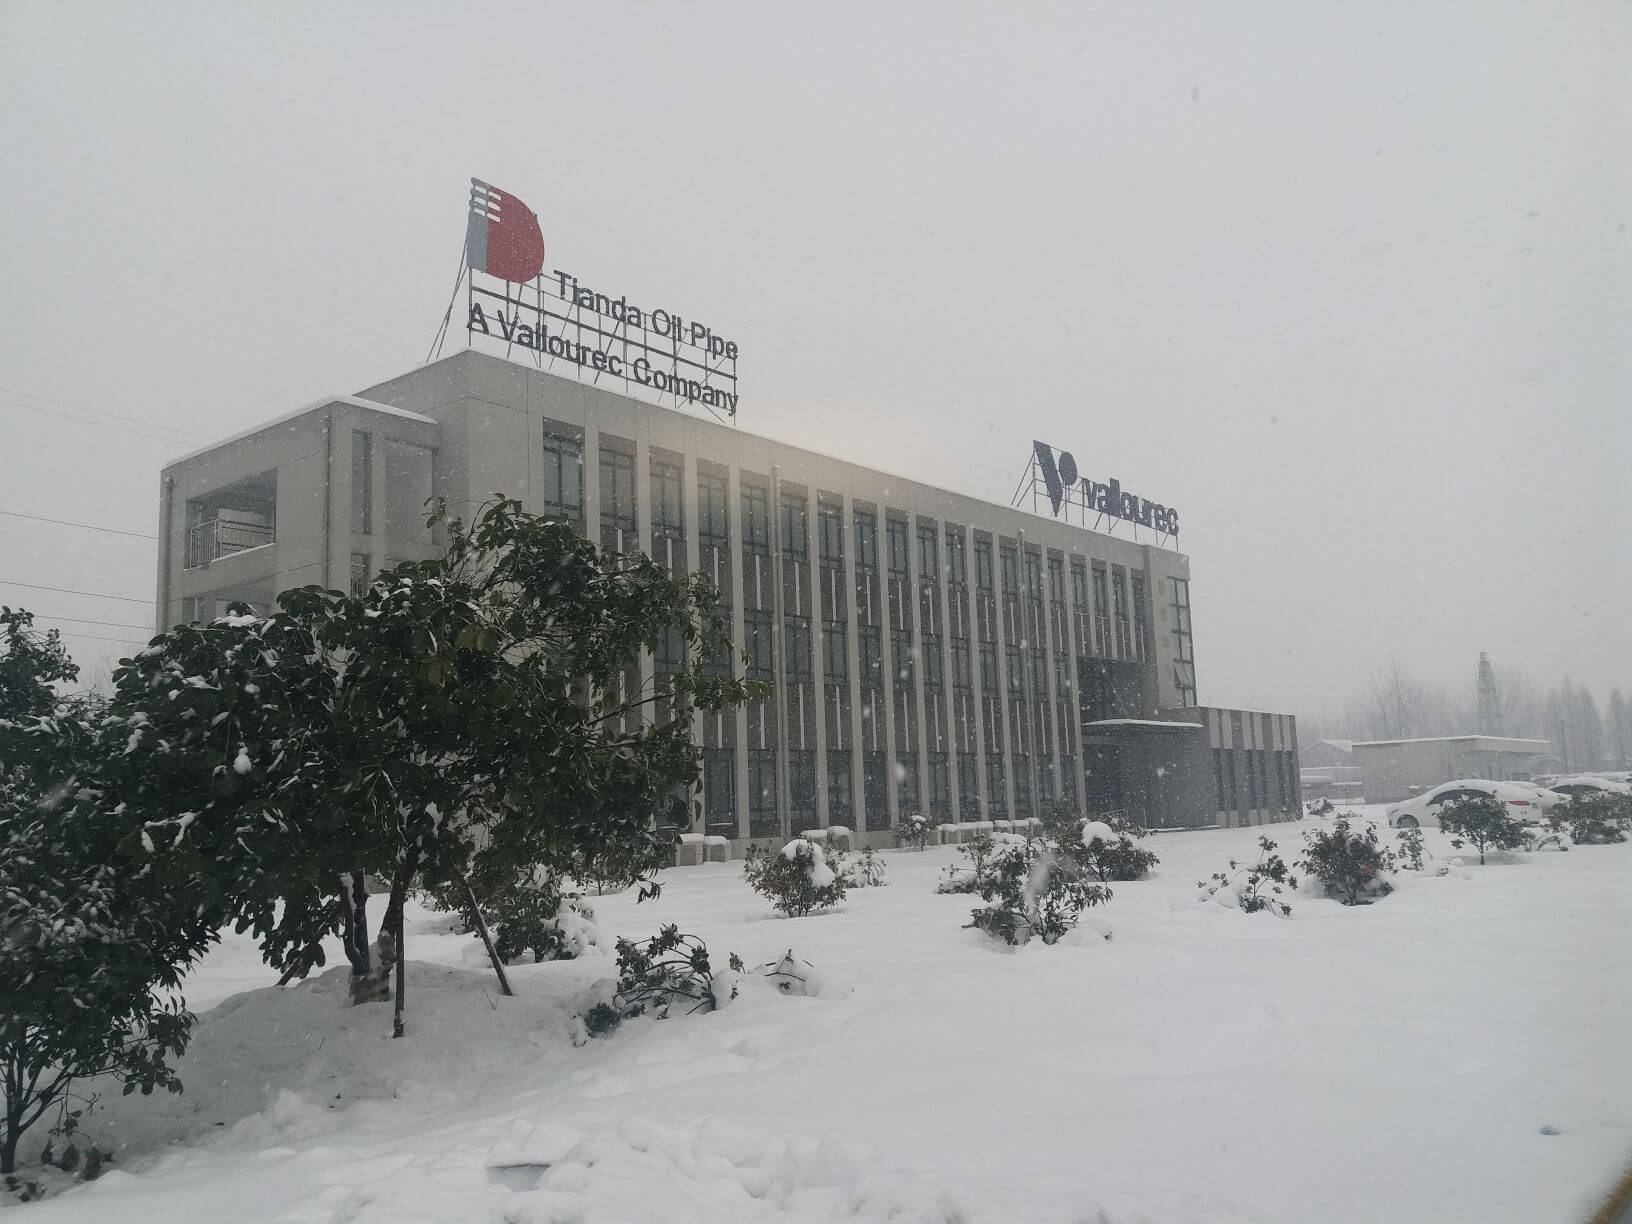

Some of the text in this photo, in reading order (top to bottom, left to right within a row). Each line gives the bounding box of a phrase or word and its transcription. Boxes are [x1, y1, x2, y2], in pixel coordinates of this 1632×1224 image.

[466, 302, 739, 417] A Vallourec Company
[554, 269, 738, 360] Tianda Oil Pipe
[1081, 477, 1179, 536] vallourec
